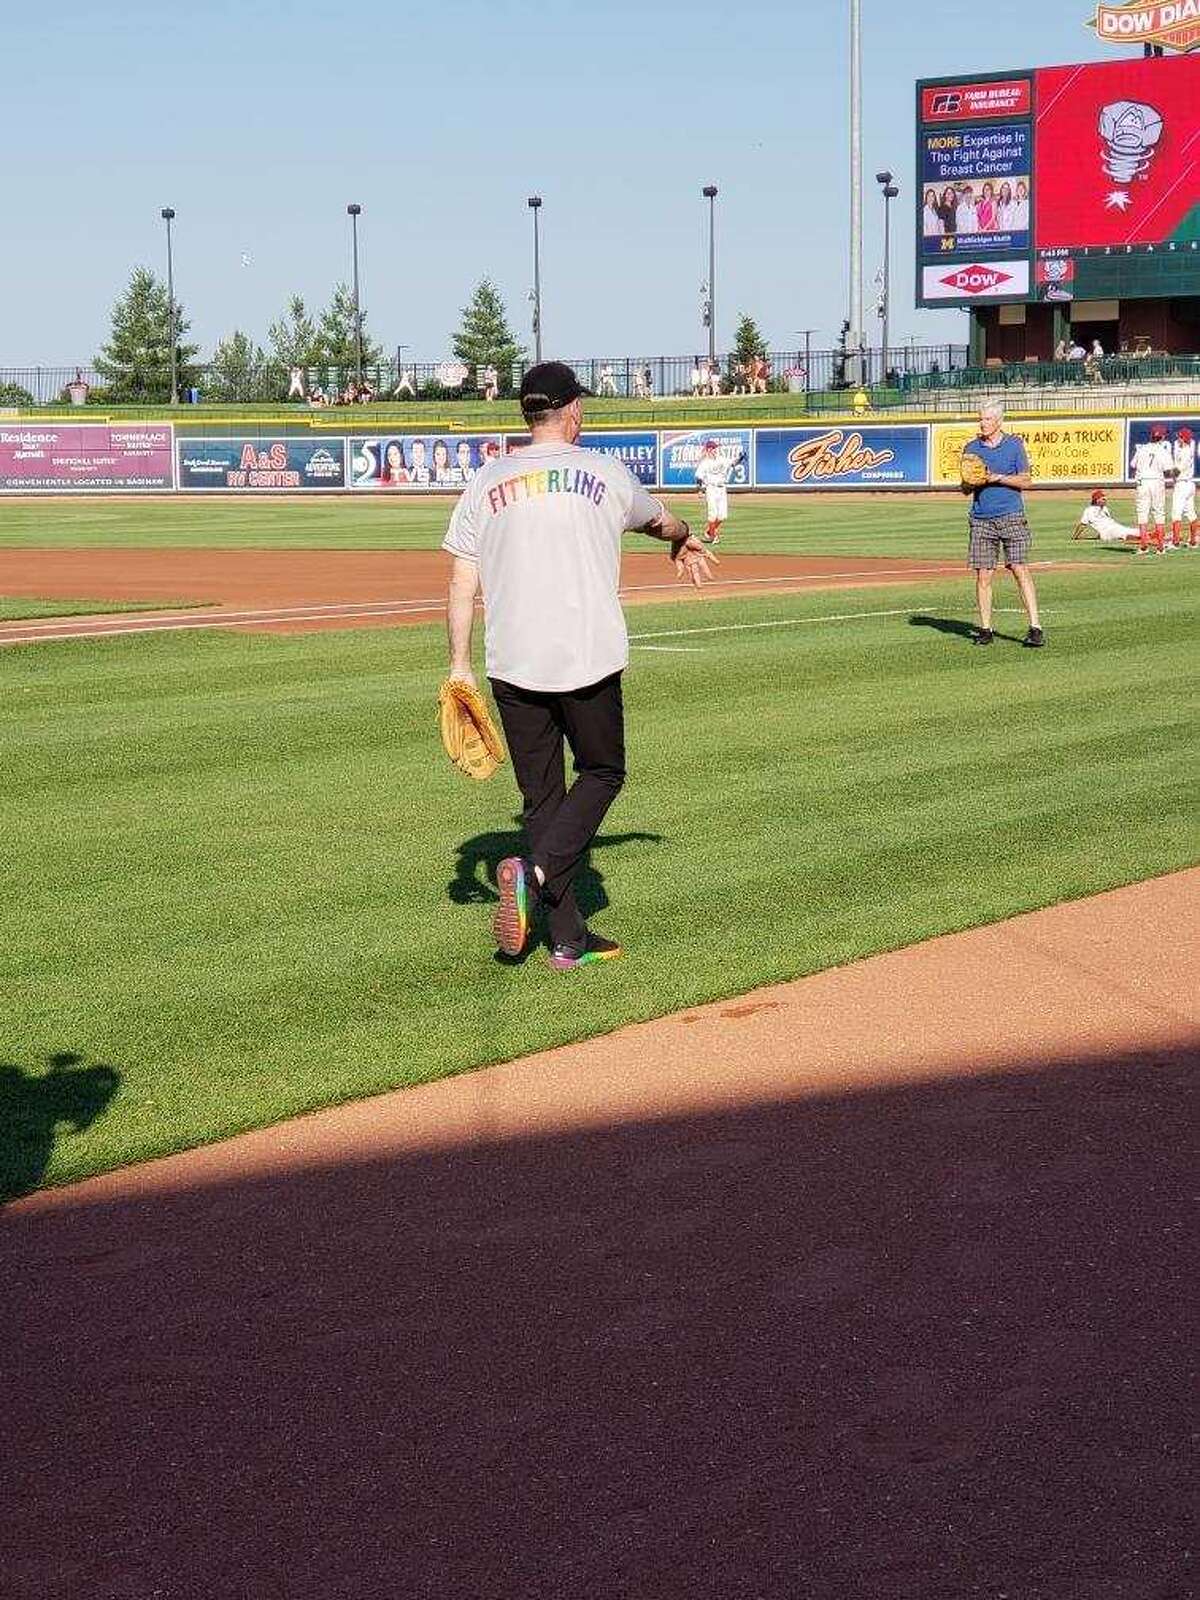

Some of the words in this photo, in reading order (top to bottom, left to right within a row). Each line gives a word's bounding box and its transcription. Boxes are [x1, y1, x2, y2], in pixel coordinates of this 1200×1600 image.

[1102, 11, 1153, 33] DOW
[1160, 0, 1200, 27] DIA
[927, 135, 961, 149] MORE
[963, 133, 1012, 148] Expertise
[930, 151, 950, 162] The
[953, 149, 980, 162] Fight
[982, 147, 1022, 161] Against
[940, 163, 974, 176] Breast
[976, 161, 1013, 173] Cancer
[956, 273, 998, 287] DOW
[0, 432, 59, 442] Residence
[1034, 431, 1059, 443] AND
[1062, 431, 1071, 443] A
[1075, 429, 1113, 443] TRUCK
[240, 443, 289, 471] A&S
[789, 430, 894, 481] Fisher
[73, 478, 112, 486] LOCATED
[249, 471, 300, 486] CENTER
[488, 468, 606, 515] FITTERLING
